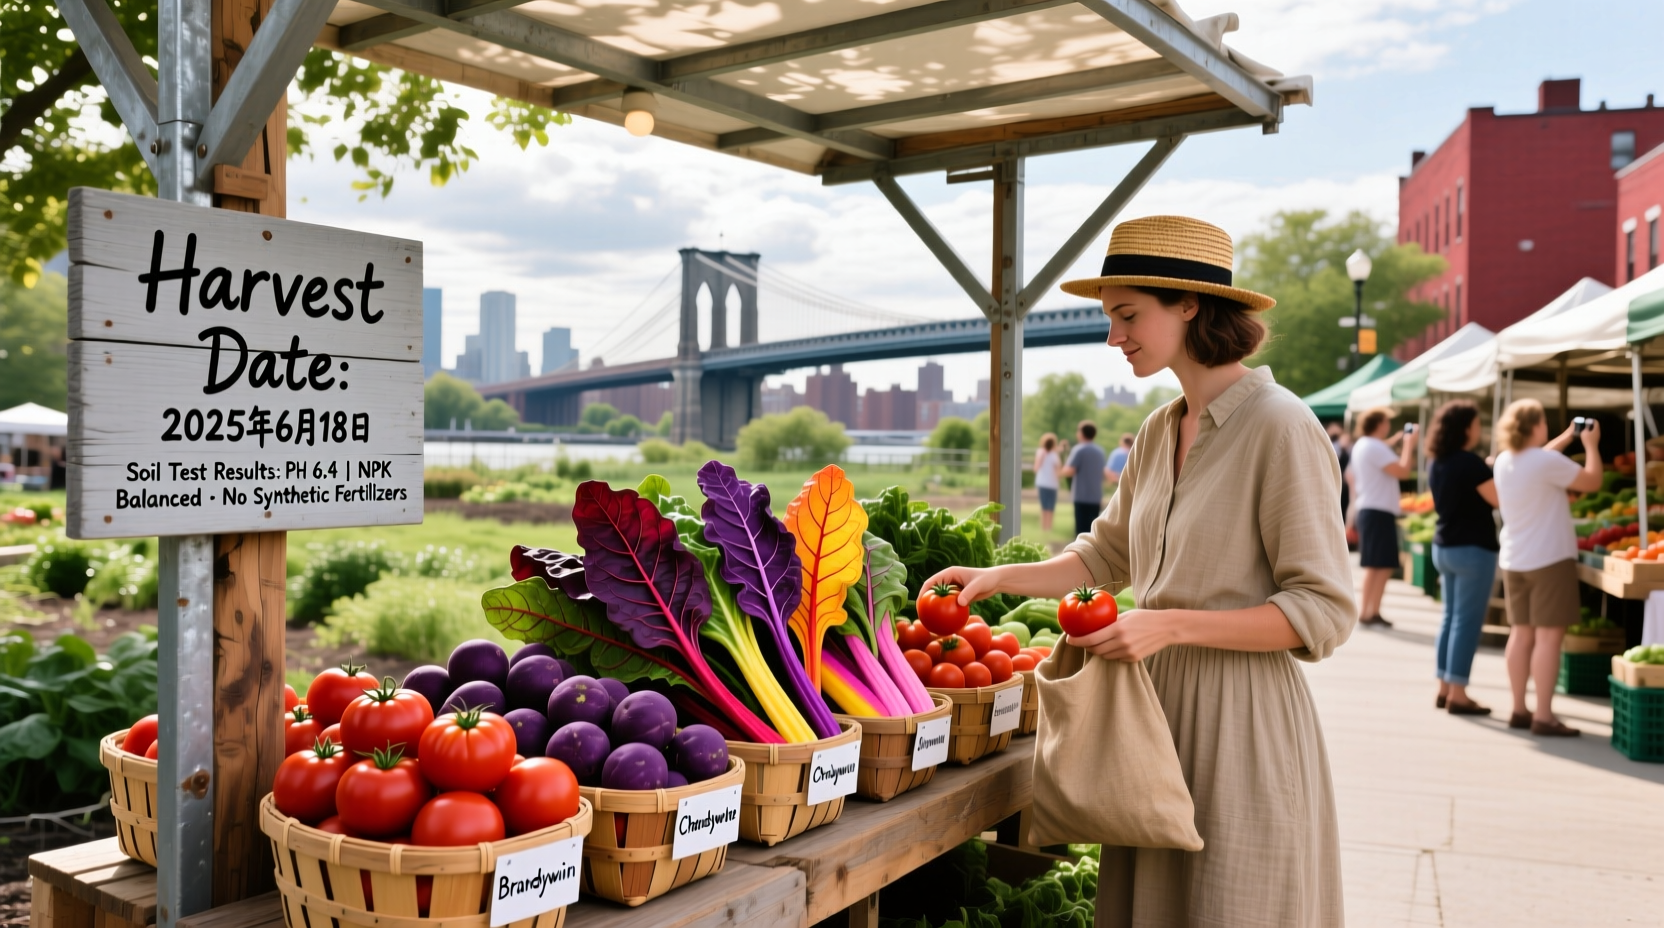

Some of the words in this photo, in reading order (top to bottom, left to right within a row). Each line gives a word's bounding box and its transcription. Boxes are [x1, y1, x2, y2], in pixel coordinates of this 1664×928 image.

[138, 229, 384, 324] Harvest
[198, 326, 349, 395] Date:
[161, 405, 370, 449] 2025年6月18日
[126, 461, 161, 481] Soil
[168, 462, 207, 481] Test
[214, 460, 281, 481] Results:
[286, 460, 307, 480] PH
[312, 460, 338, 480] 6.4
[358, 460, 392, 479] NPK
[116, 488, 201, 509] Balanced
[222, 487, 247, 506] No
[253, 484, 330, 510] Synthetic
